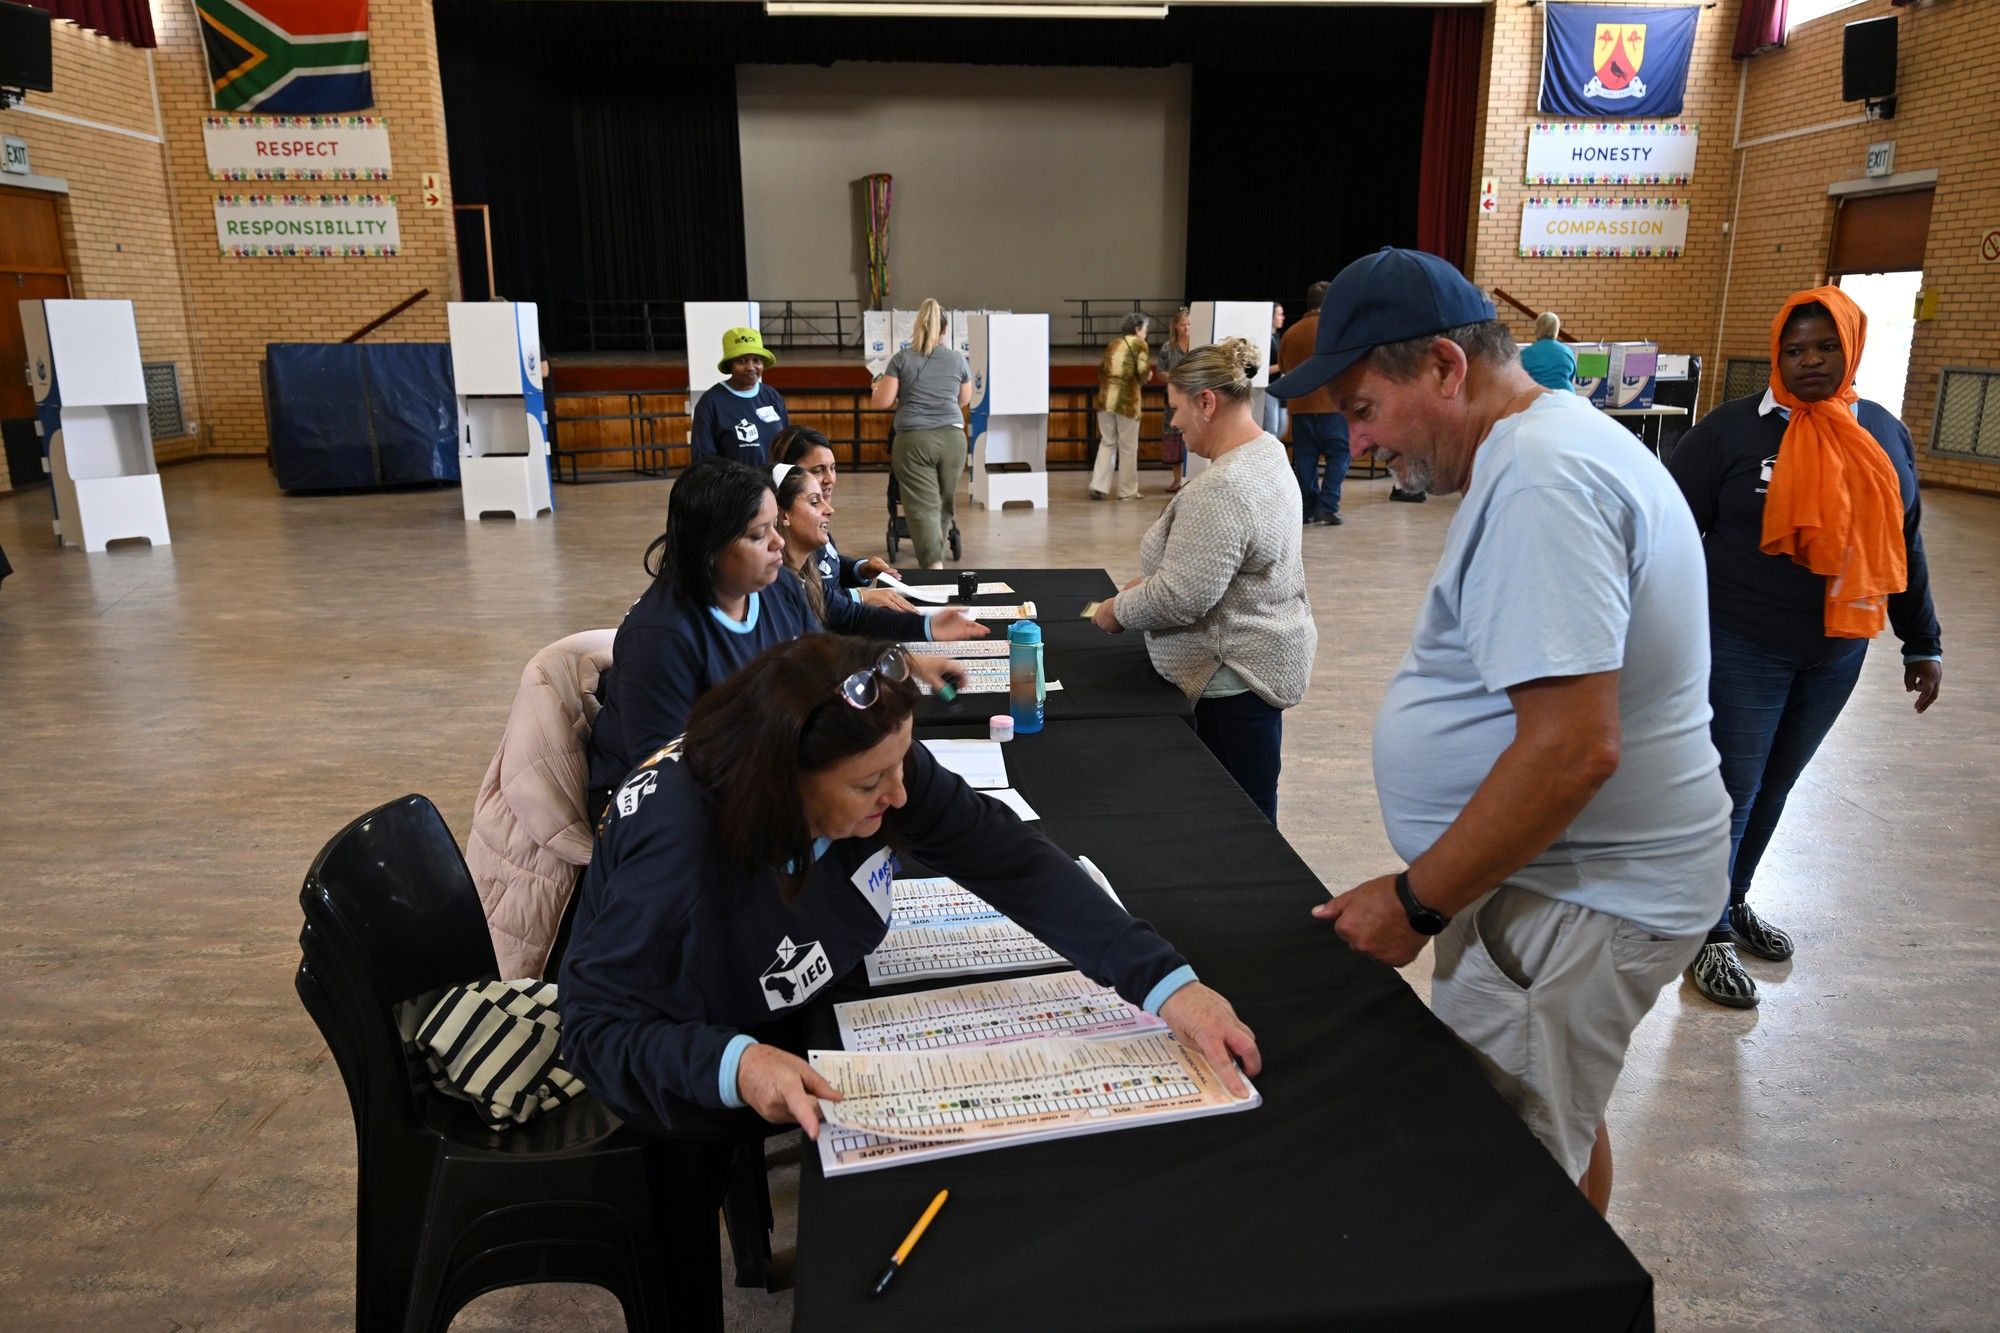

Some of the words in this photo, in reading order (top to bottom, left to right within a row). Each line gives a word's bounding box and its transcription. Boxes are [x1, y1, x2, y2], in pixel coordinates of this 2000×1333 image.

[6, 144, 27, 165] EXIT
[255, 141, 339, 157] RESPECT
[1571, 147, 1653, 161] HONESTY
[1867, 150, 1888, 169] EXIT
[226, 220, 387, 235] RESPONSIBILITY
[1546, 220, 1664, 235] COMPASSION
[1657, 364, 1668, 372] XIT
[801, 955, 827, 988] IEC
[859, 1147, 895, 1159] CAPE
[899, 1139, 965, 1152] ESTERN
